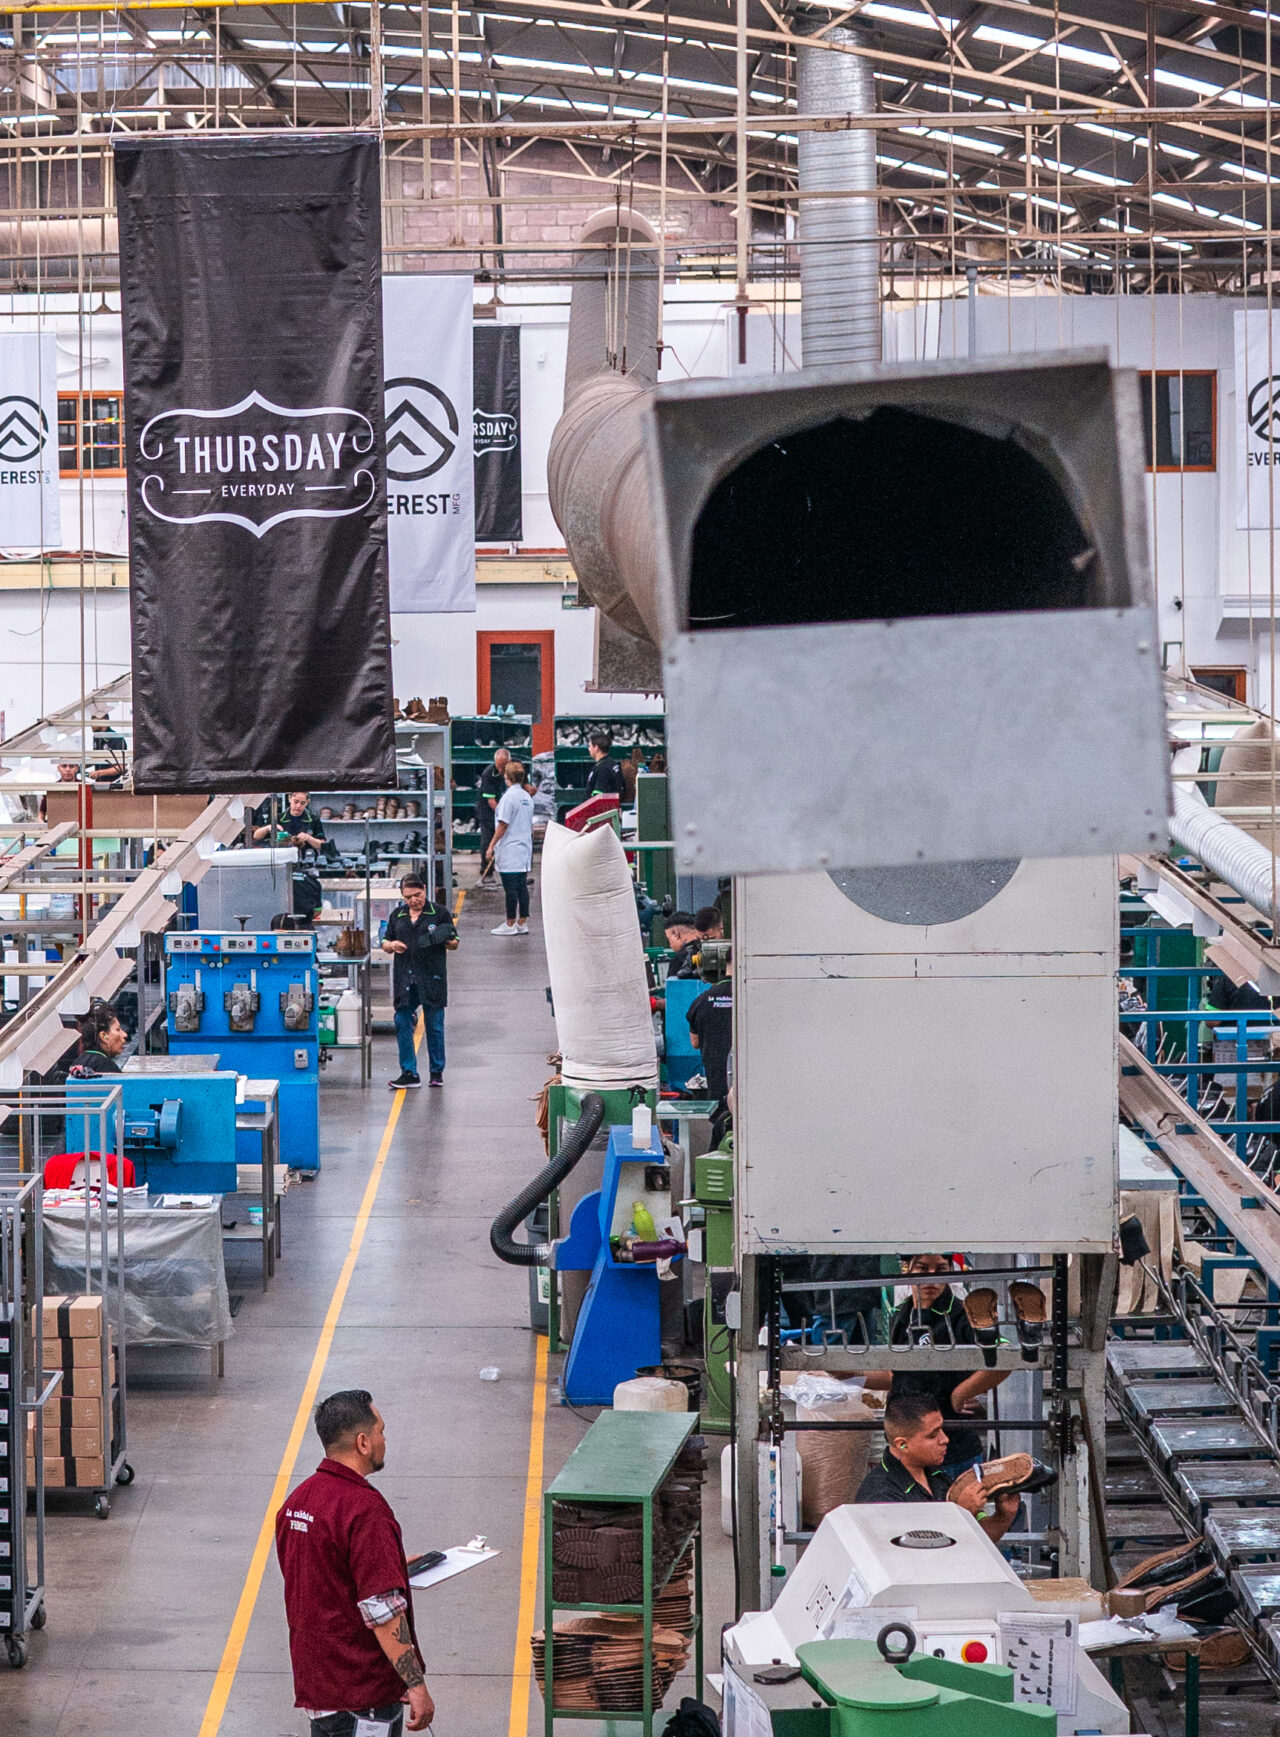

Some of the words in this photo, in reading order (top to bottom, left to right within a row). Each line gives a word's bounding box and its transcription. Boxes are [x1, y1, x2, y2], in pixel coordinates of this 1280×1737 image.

[473, 422, 508, 435] RSDAY
[174, 432, 346, 474] THURSDAY
[221, 483, 295, 497] EVERYDAY
[387, 494, 450, 515] EREST
[453, 493, 461, 515] MFG
